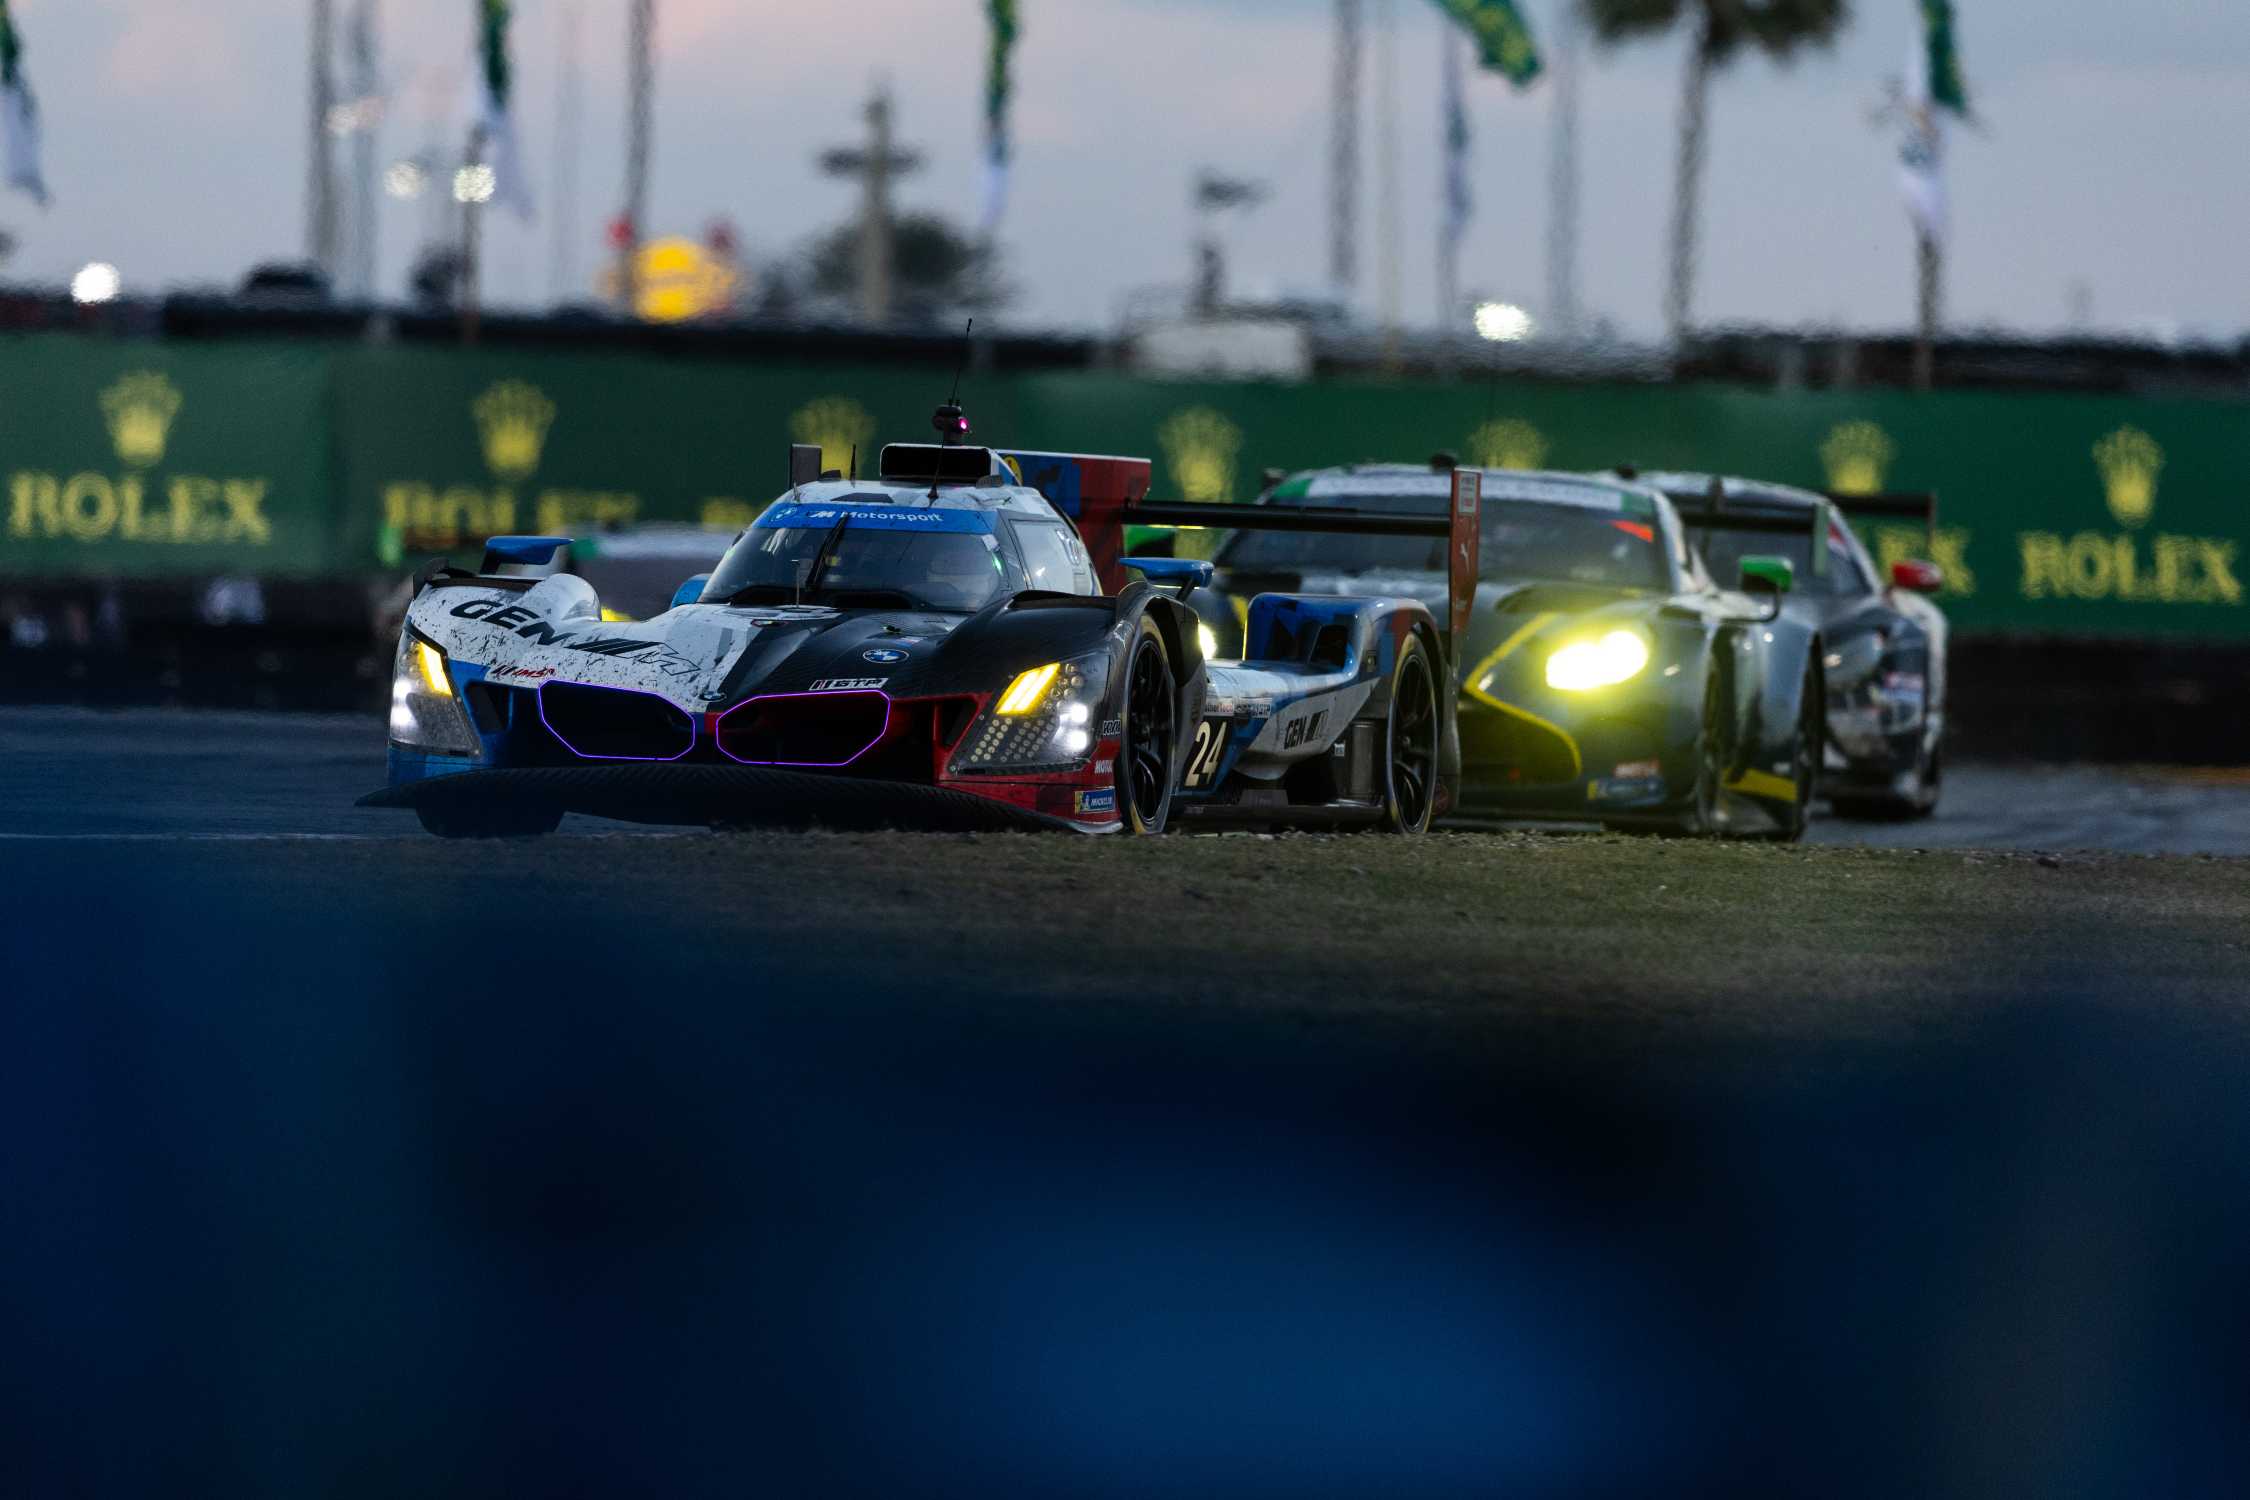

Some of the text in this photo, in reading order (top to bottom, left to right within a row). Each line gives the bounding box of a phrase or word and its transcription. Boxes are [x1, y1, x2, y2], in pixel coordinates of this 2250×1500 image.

[9, 471, 271, 545] ROLEX
[840, 511, 944, 523] Motorsport
[2019, 528, 2242, 603] ROLEX
[450, 599, 577, 646] GEN
[834, 679, 883, 688] GTP
[1184, 721, 1228, 787] 24
